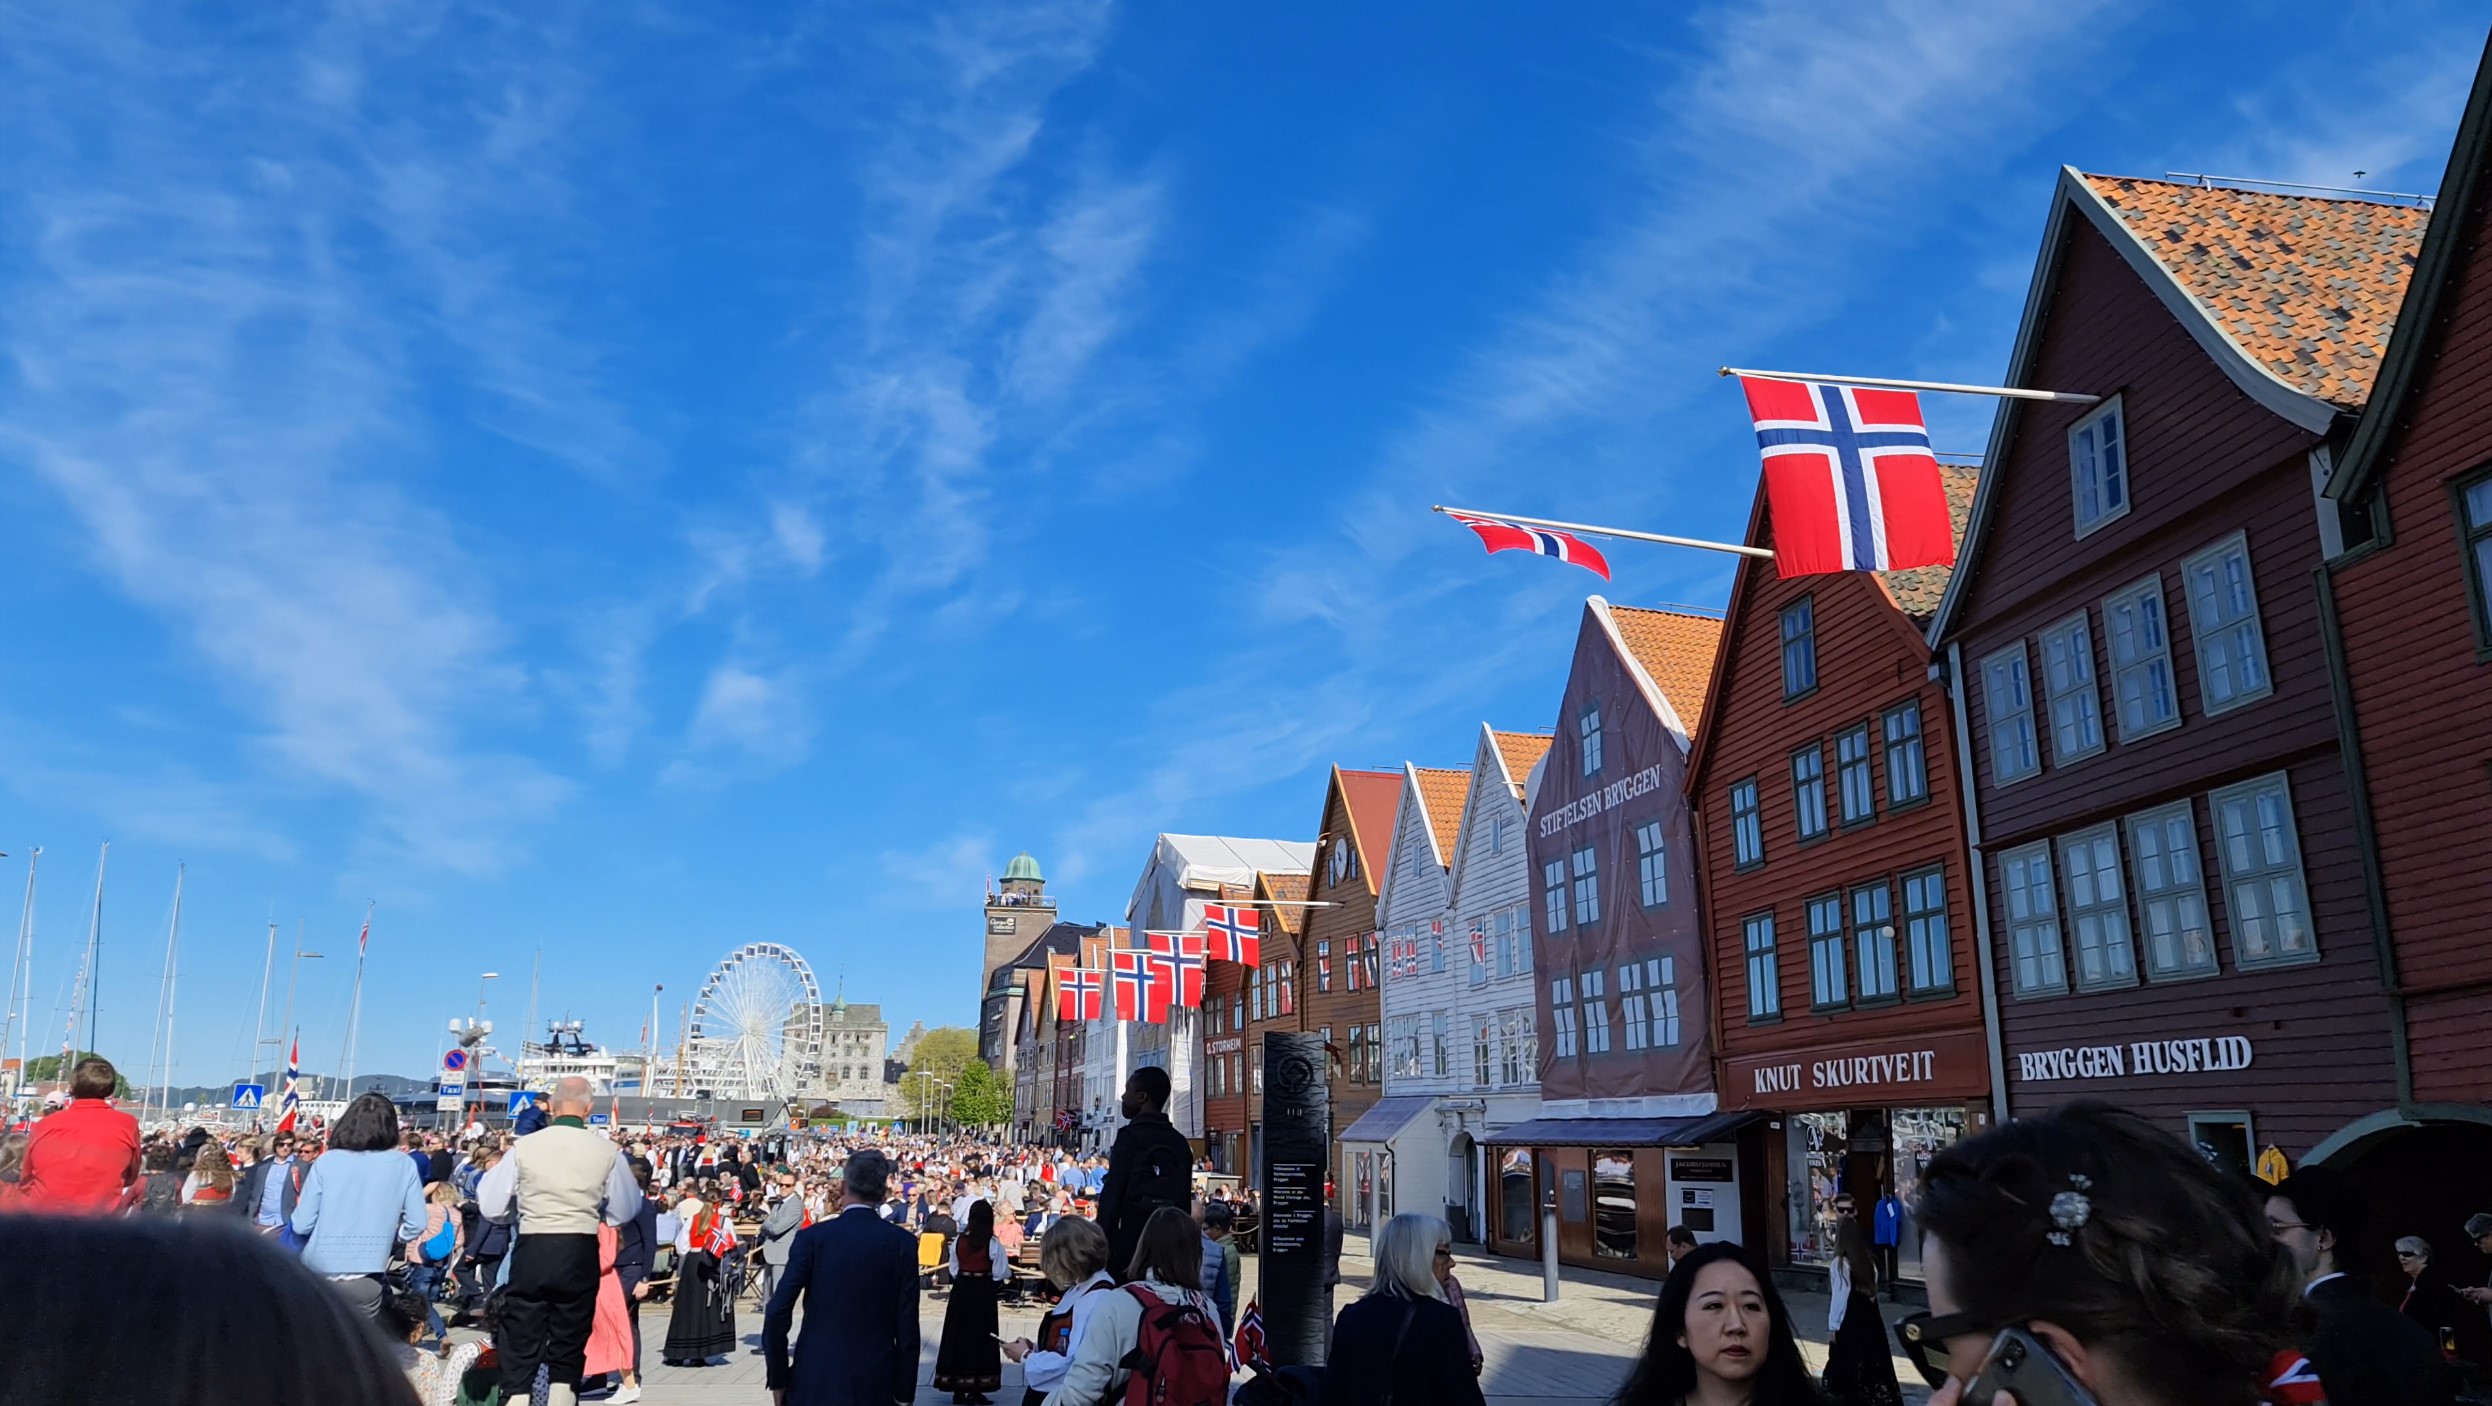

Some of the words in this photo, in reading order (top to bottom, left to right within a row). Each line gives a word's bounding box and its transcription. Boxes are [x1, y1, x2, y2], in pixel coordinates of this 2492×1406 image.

[1540, 790, 1602, 838] STIFTELSEN
[1604, 764, 1661, 811] BRYGGEN
[1754, 1064, 1802, 1093] KNUT
[1812, 1050, 1935, 1087] SKURTVEIT
[2019, 1046, 2125, 1081] BRYGGEN
[2131, 1035, 2253, 1075] HUSFLID
[442, 1085, 461, 1094] Taxi
